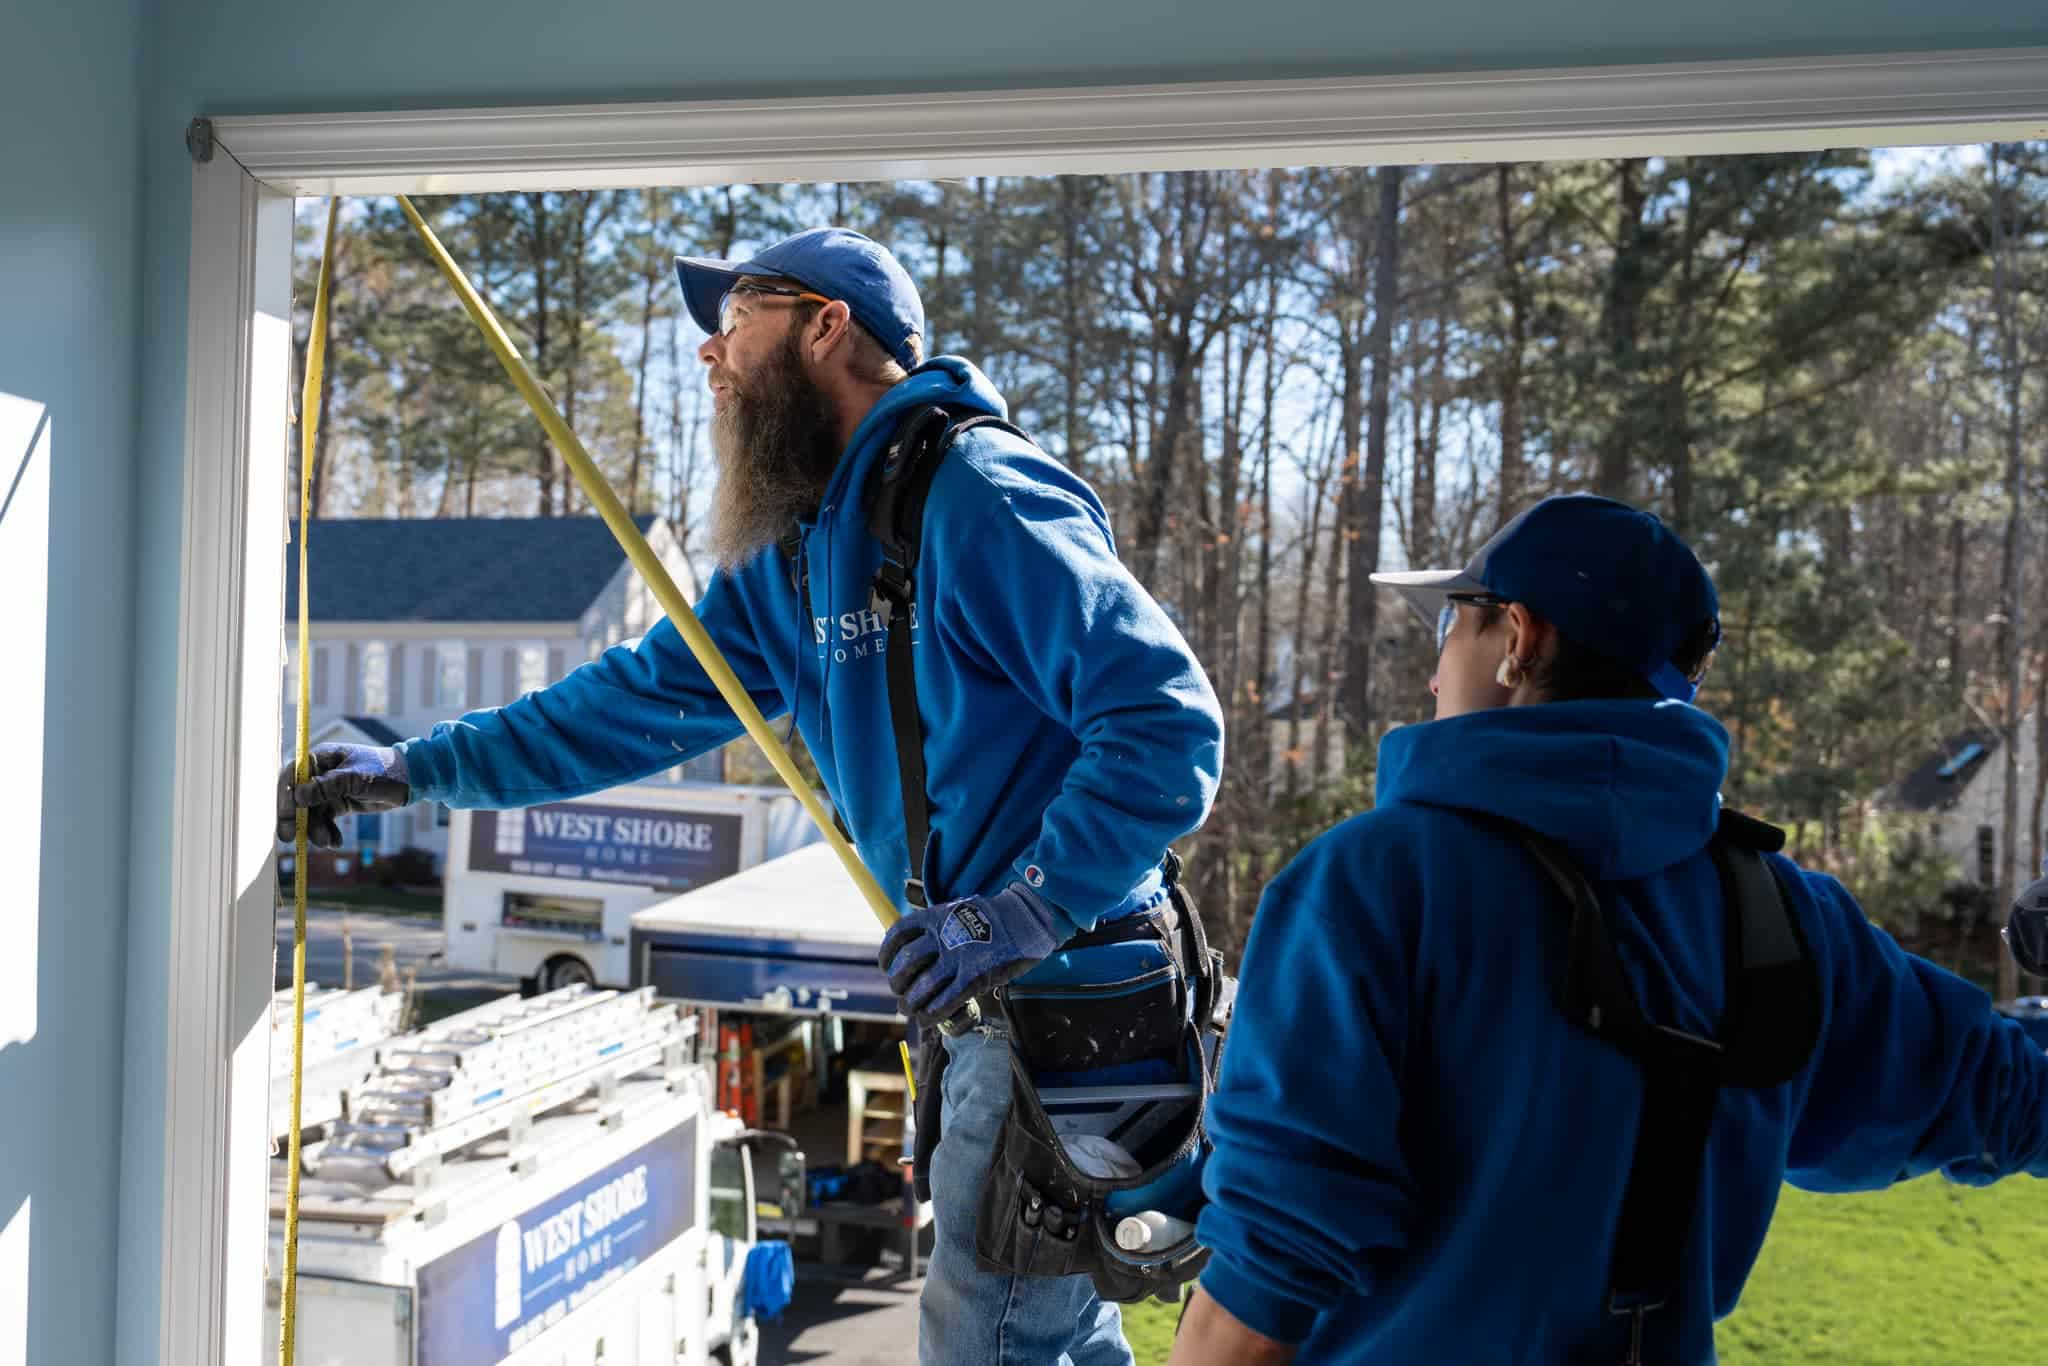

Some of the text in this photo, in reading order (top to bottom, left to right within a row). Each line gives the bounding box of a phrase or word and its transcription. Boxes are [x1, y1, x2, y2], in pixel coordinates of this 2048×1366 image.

[839, 602, 919, 640] SHE
[834, 638, 885, 663] OME
[530, 809, 713, 852] WEST SHORE
[584, 846, 652, 865] HOME
[960, 907, 987, 939] HELIX
[522, 1163, 648, 1274] WEST SHORE
